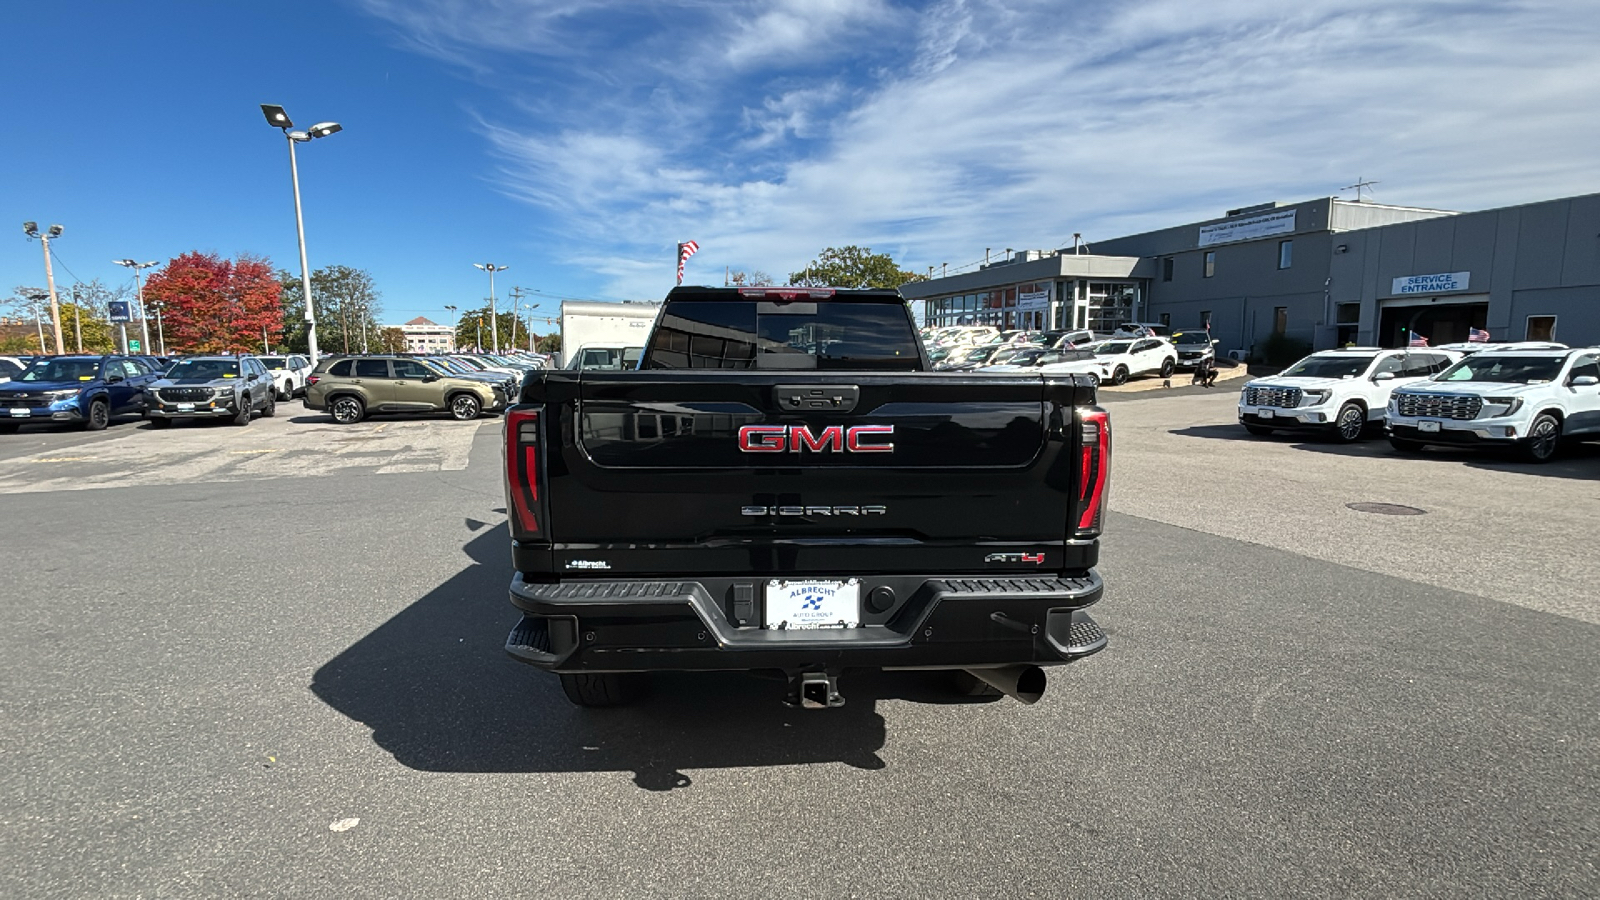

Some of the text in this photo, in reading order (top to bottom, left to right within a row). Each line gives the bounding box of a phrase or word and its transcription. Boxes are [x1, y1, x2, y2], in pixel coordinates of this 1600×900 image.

[1408, 274, 1452, 285] SERVICE
[1402, 282, 1458, 292] ENTRANCE
[738, 424, 895, 453] GMC
[741, 505, 887, 516] SIERRA
[984, 552, 1046, 565] AT4
[790, 586, 836, 598] ALBRECHT
